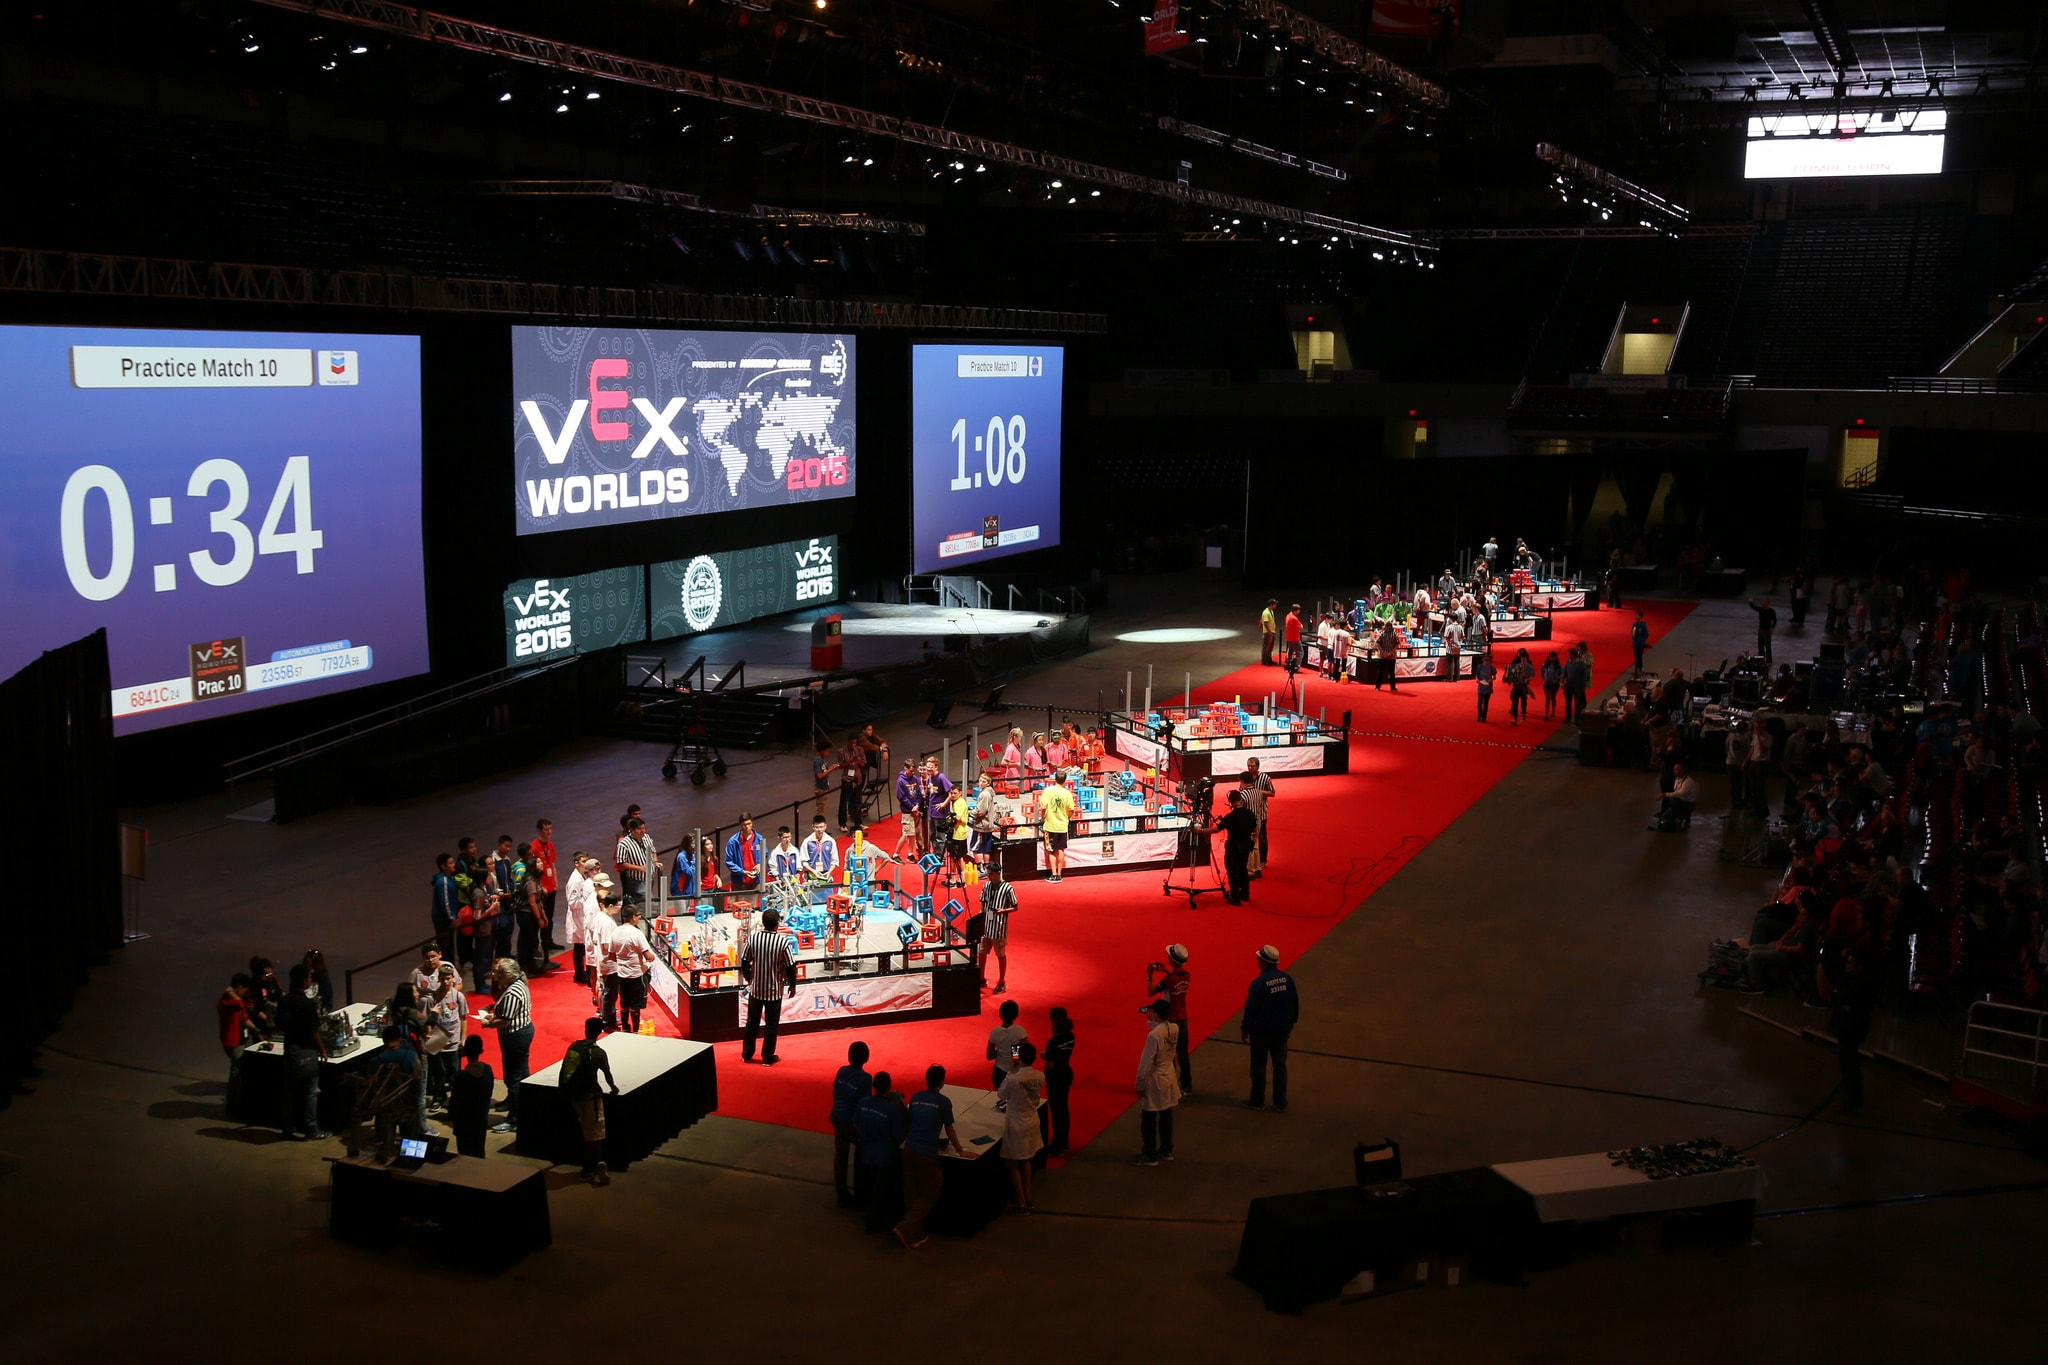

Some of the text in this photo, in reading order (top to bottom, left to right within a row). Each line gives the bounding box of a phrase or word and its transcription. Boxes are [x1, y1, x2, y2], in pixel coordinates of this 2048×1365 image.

[1793, 164, 1891, 174] COMPETITION
[121, 358, 278, 378] Practice Match 10
[692, 361, 727, 369] PRESENTED
[728, 361, 737, 369] BY
[970, 361, 1018, 372] Practice Match 10
[951, 414, 1027, 491] 1:08
[787, 455, 848, 490] 2015
[526, 468, 689, 517] WORLDS
[60, 455, 323, 601] 0:34
[795, 538, 832, 568] VEX
[796, 564, 833, 580] WORLDS
[512, 579, 571, 615] VEX
[796, 576, 833, 601] 2015
[515, 610, 571, 632] WORLDS
[196, 640, 238, 663] VEX
[280, 641, 344, 659] AUTONOMOUS WINNER
[515, 624, 572, 657] 2015
[196, 657, 238, 669] ROBOTICS
[196, 665, 239, 677] COMPETITION
[261, 664, 294, 684] 2355B
[321, 653, 350, 673] 7792A
[197, 673, 242, 696] Prac 10
[130, 686, 181, 708] 6841C 24
